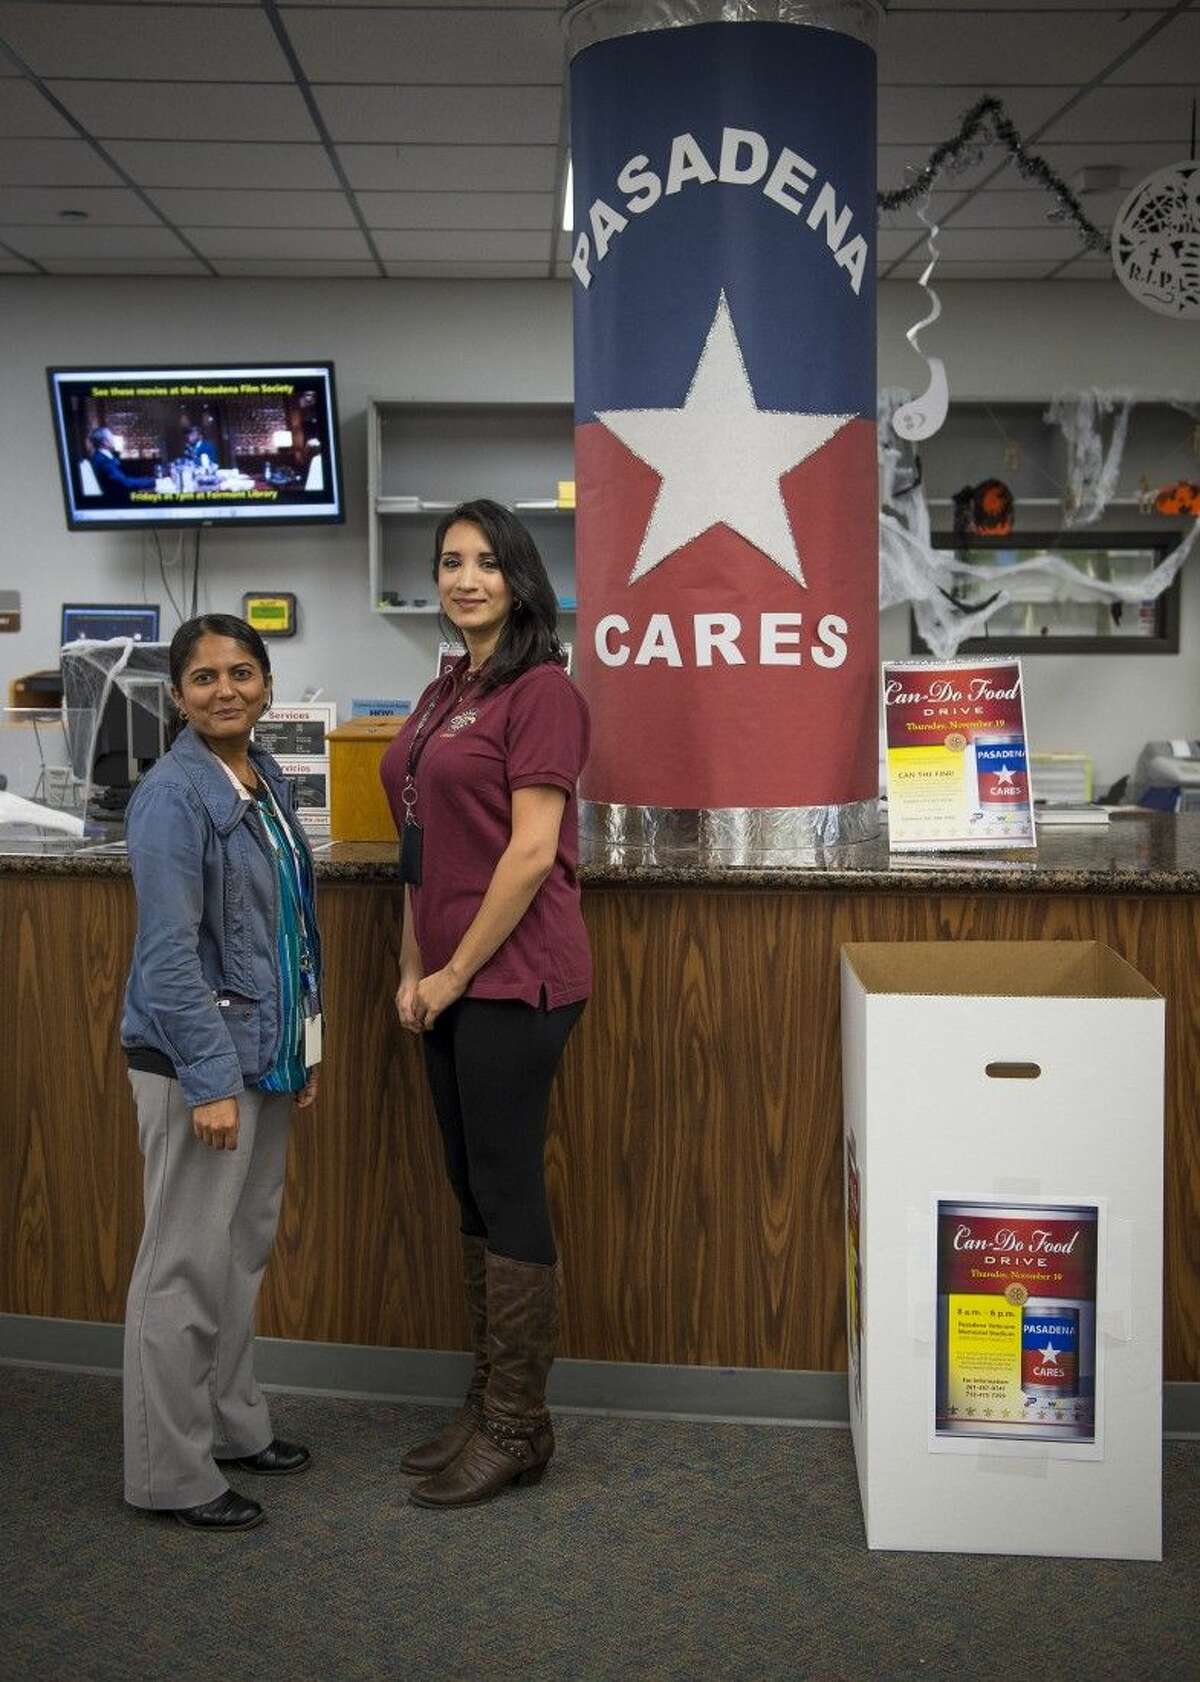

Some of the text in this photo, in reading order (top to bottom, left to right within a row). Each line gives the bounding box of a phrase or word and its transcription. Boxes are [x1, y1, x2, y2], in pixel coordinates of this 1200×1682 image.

[571, 127, 868, 295] PASADENA
[92, 387, 108, 396] See
[136, 387, 168, 395] movies
[169, 386, 179, 395] at
[181, 386, 195, 395] the
[197, 385, 239, 395] Pasadena
[240, 384, 259, 394] Film
[261, 384, 294, 394] Society
[594, 612, 849, 669] CARES
[885, 678, 1022, 706] Can-Do Food
[268, 710, 310, 720] Services
[923, 707, 984, 716] DRIVE
[949, 720, 993, 731] November
[990, 787, 1022, 796] CARES
[953, 1224, 1080, 1255] Can-Do Food
[984, 1256, 1049, 1268] DRIVE
[1033, 1366, 1065, 1378] CARES
